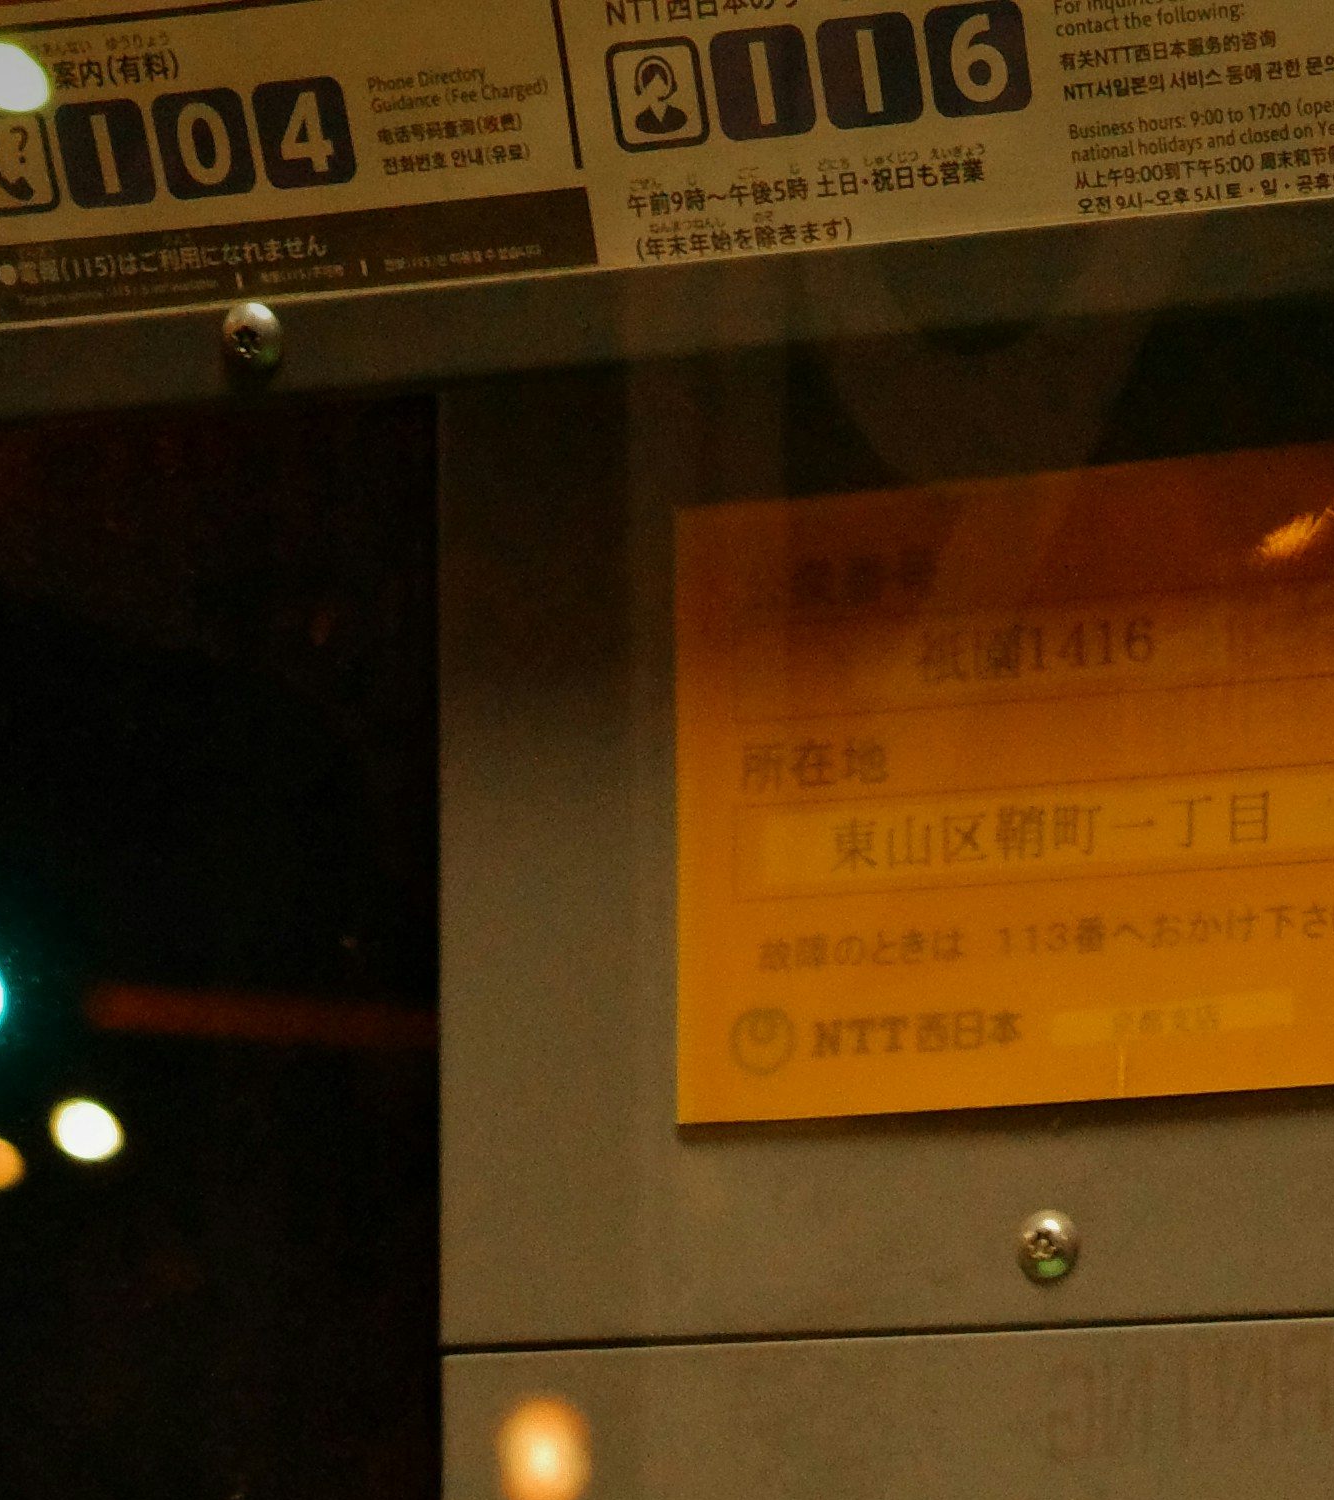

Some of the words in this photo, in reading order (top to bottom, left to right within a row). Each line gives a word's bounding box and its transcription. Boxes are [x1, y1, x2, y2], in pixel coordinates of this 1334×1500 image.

[1054, 0, 1079, 15] For
[1088, 0, 1158, 14] inquir
[1056, 18, 1118, 37] contact
[1125, 12, 1151, 29] the
[1157, 2, 1246, 25] following:
[367, 76, 413, 92] Phone
[418, 67, 485, 87] Directory
[748, 12, 1009, 127] 116
[1064, 73, 1165, 101] NTT서일본의
[1170, 67, 1223, 91] 서비스
[1266, 59, 1301, 80] 관한
[371, 94, 441, 113] Guidance
[445, 88, 477, 106] (Fee
[482, 76, 548, 102] Charged)
[1069, 118, 1134, 139] Business
[1138, 115, 1186, 132] hours:
[1190, 108, 1223, 126] 9:00
[1228, 107, 1244, 124] to
[1249, 101, 1291, 121] 17:00
[90, 90, 336, 196] 104
[1071, 143, 1134, 163] national
[1138, 137, 1203, 158] holidays
[1207, 132, 1236, 148] and
[1239, 124, 1289, 145] closed
[1294, 124, 1314, 140] on
[383, 152, 447, 175] 전화번호
[1078, 197, 1111, 214] 오전
[636, 217, 853, 261] (年末年始を除きます)
[741, 736, 891, 793] 所在地
[829, 790, 1274, 875] 東山区鞘町一丁目
[757, 923, 967, 975] 故障のときは
[810, 1009, 1024, 1061] NTT西日本
